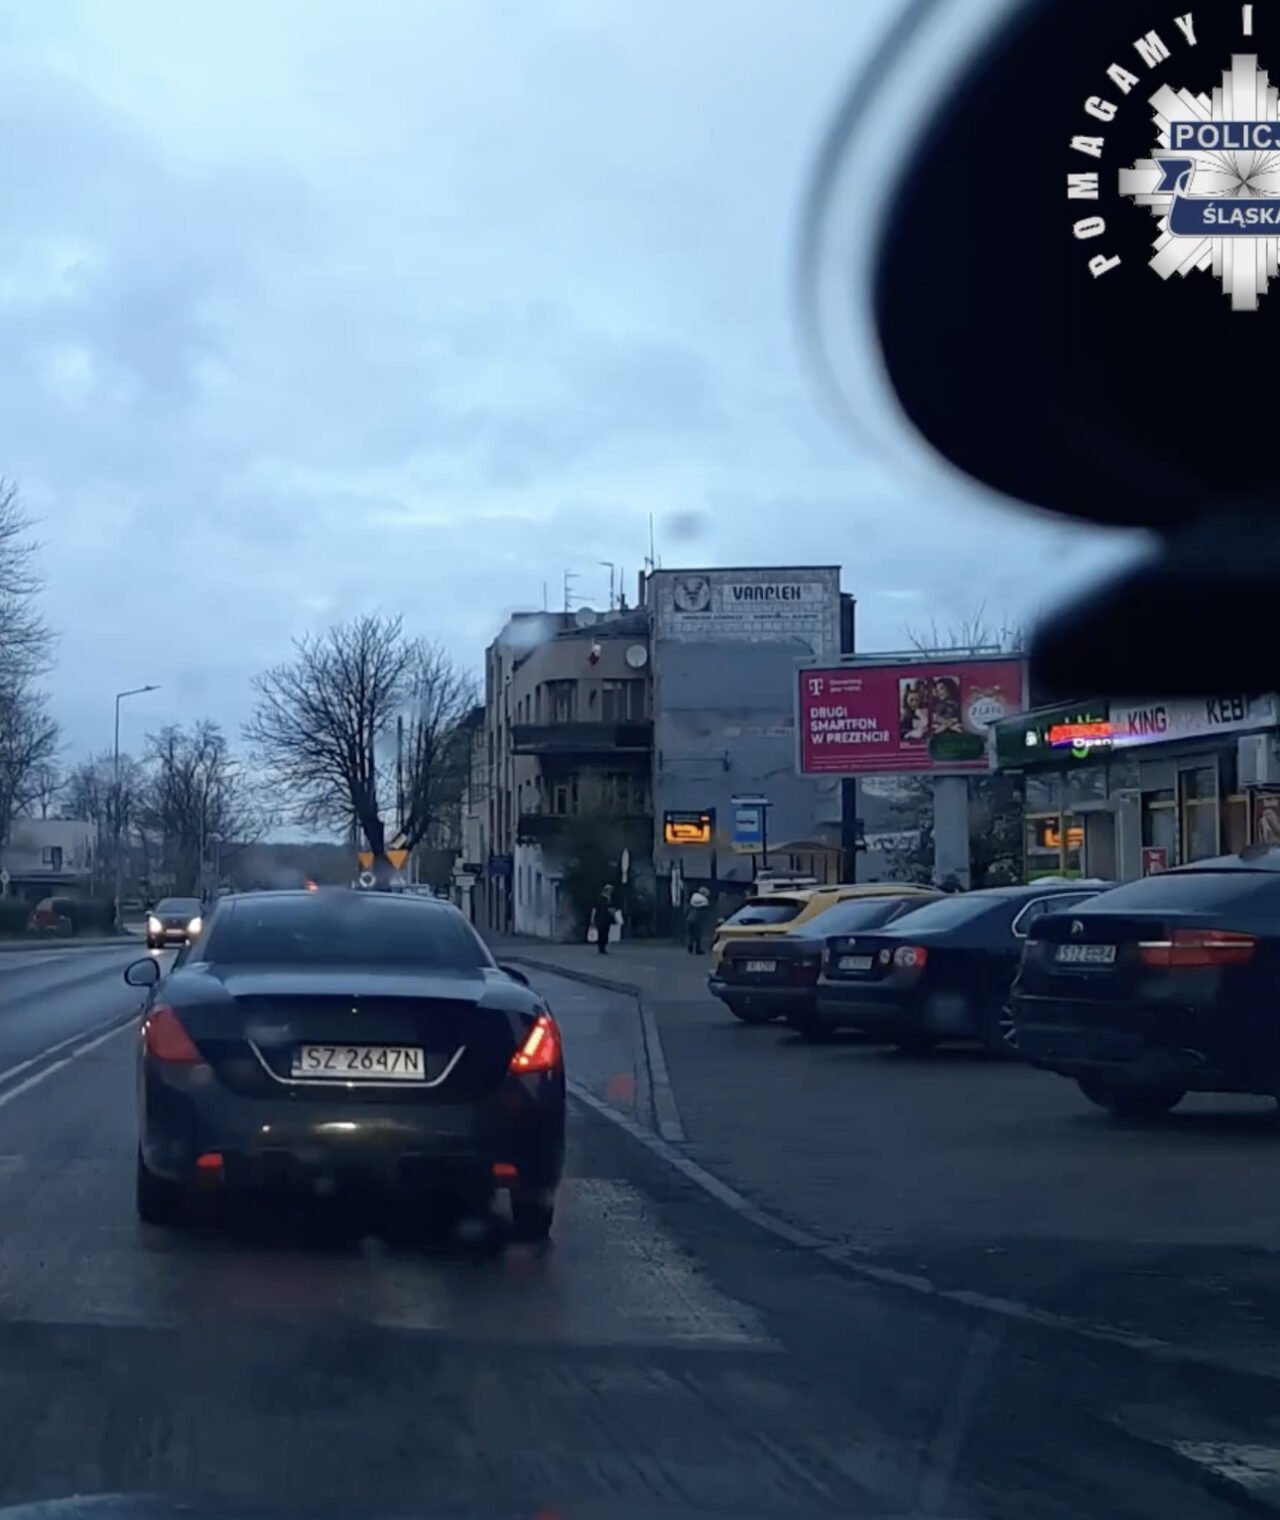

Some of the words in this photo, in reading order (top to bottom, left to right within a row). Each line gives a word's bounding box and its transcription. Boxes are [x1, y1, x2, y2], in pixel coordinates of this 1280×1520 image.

[810, 706, 847, 719] DRUGI
[810, 718, 877, 732] SMARTFON
[1127, 706, 1167, 736] KING
[811, 732, 824, 744] W
[826, 730, 889, 743] PREZENCIE
[307, 1048, 336, 1069] SZ
[346, 1049, 418, 1071] 2647N
